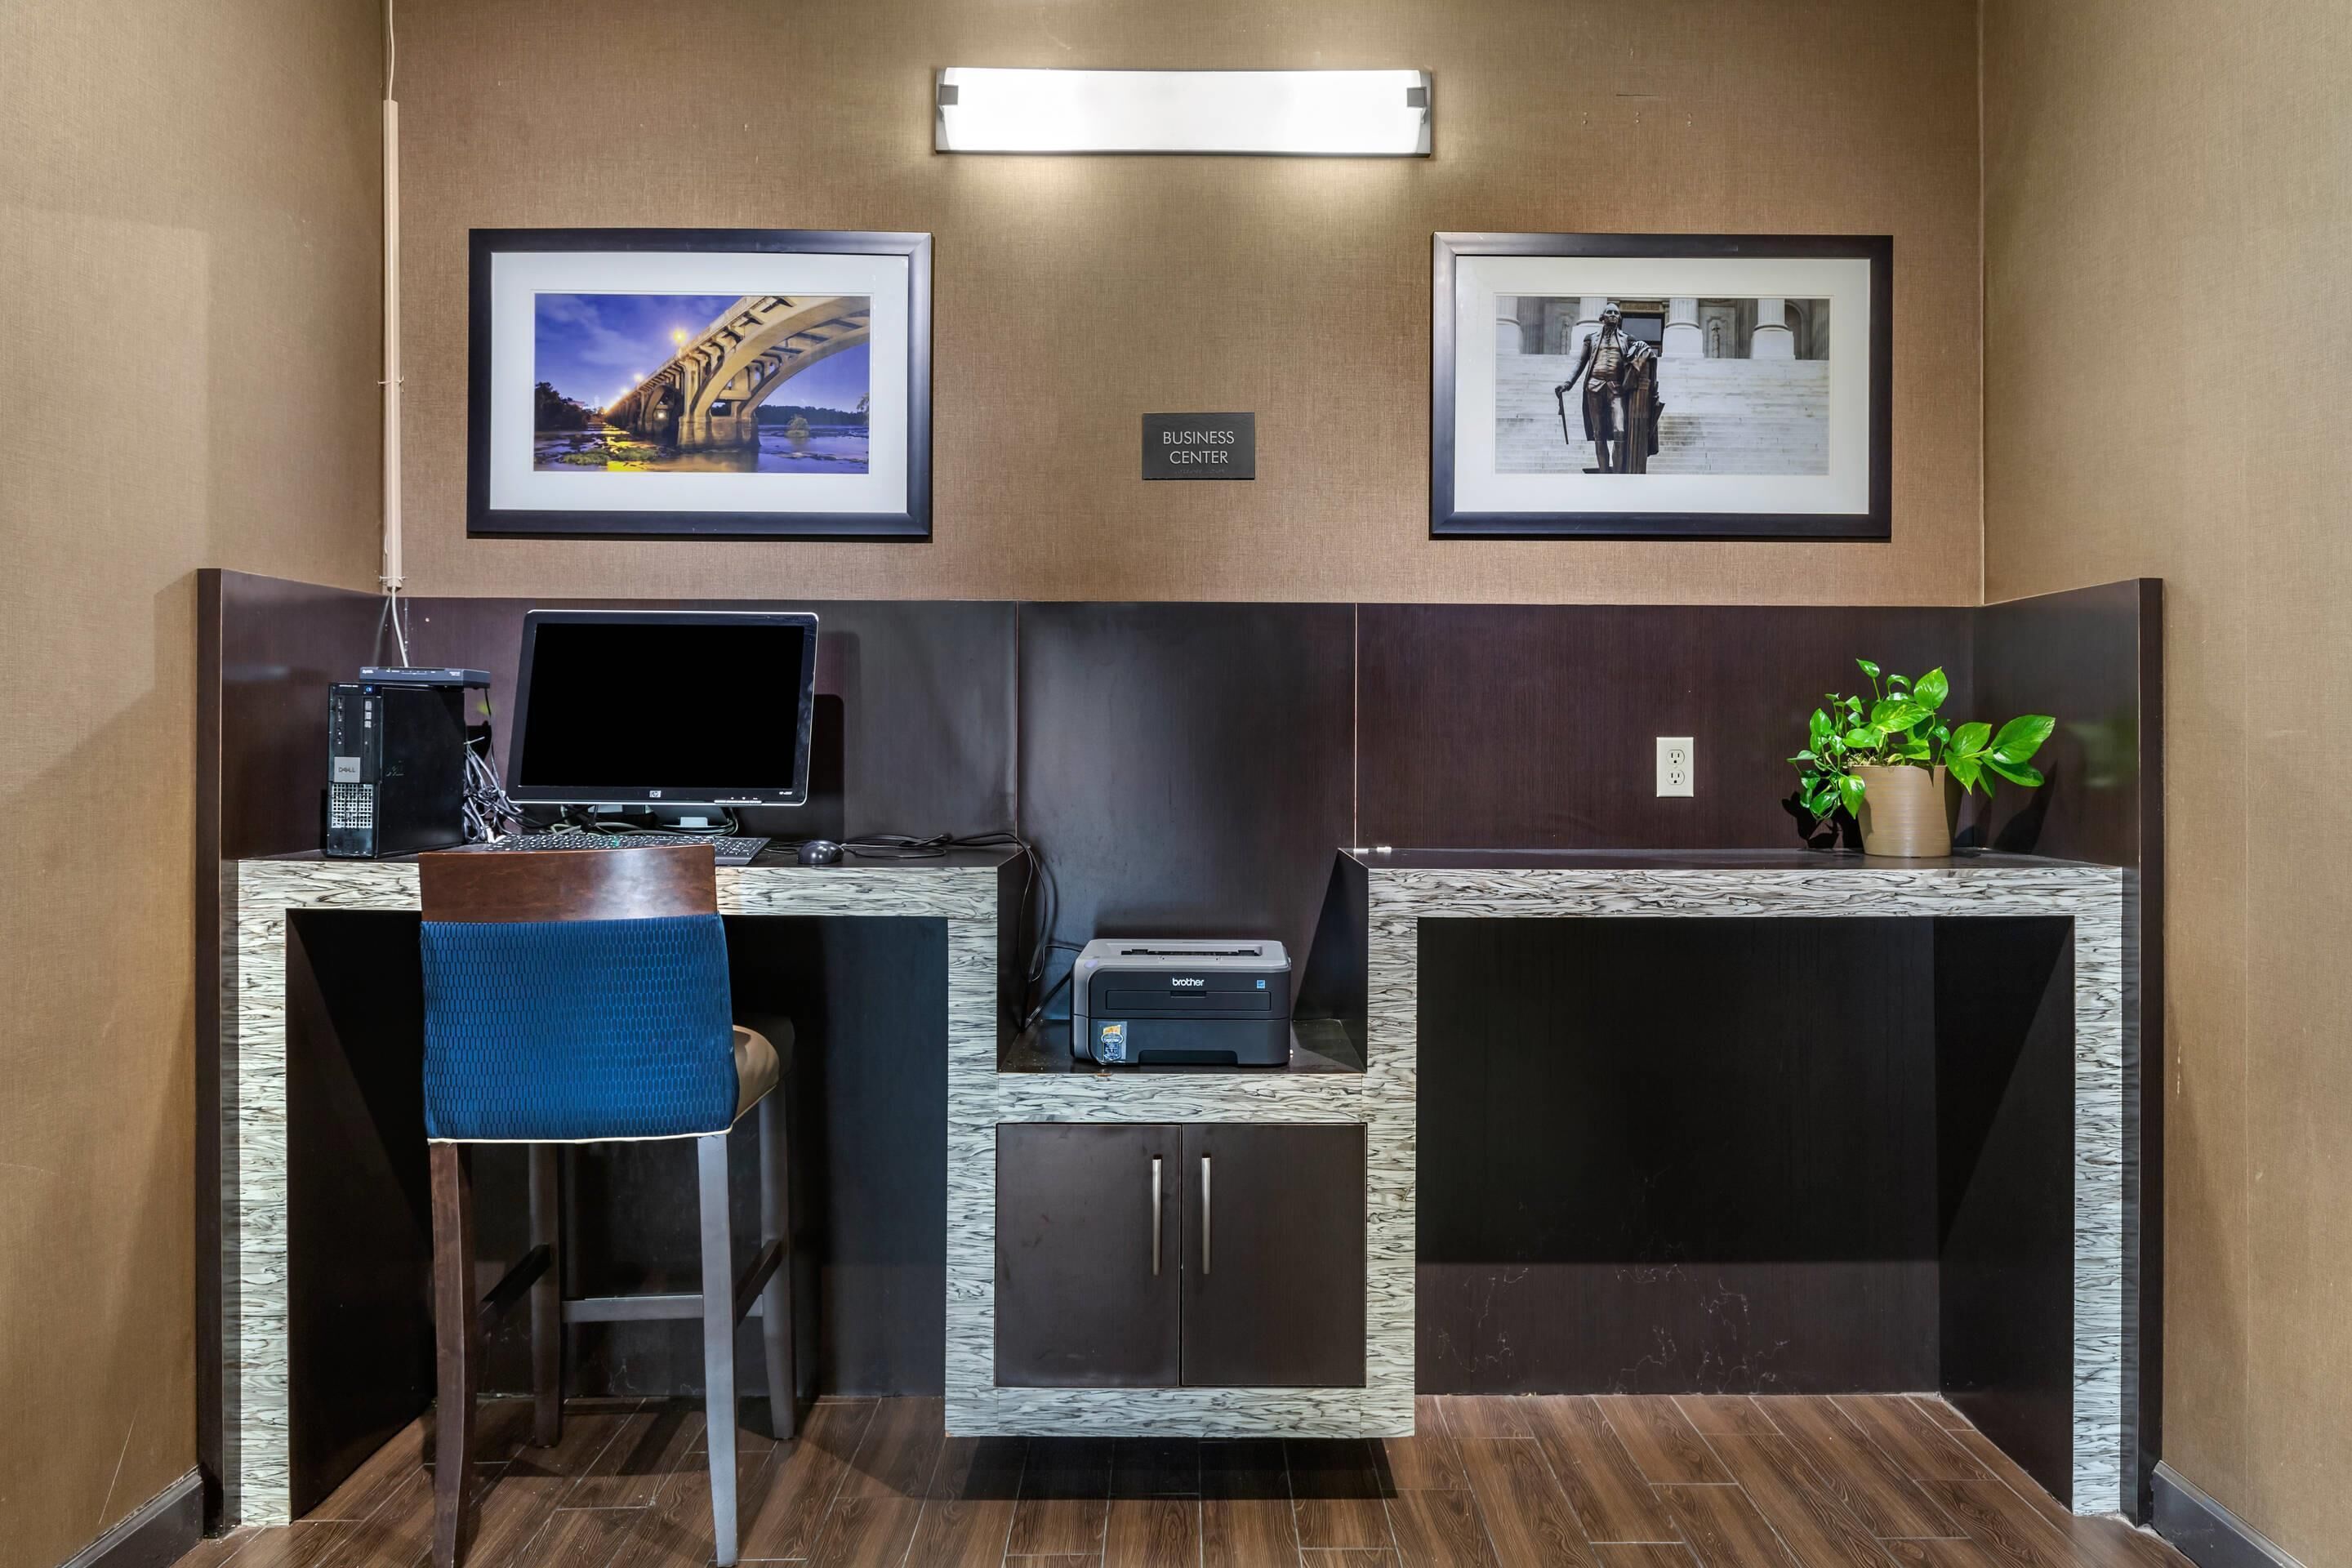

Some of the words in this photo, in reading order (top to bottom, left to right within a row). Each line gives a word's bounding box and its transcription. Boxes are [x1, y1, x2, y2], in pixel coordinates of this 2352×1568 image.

[1162, 430, 1235, 445] BUSINESS
[1169, 450, 1229, 465] CENTER
[1172, 978, 1205, 987] brother
